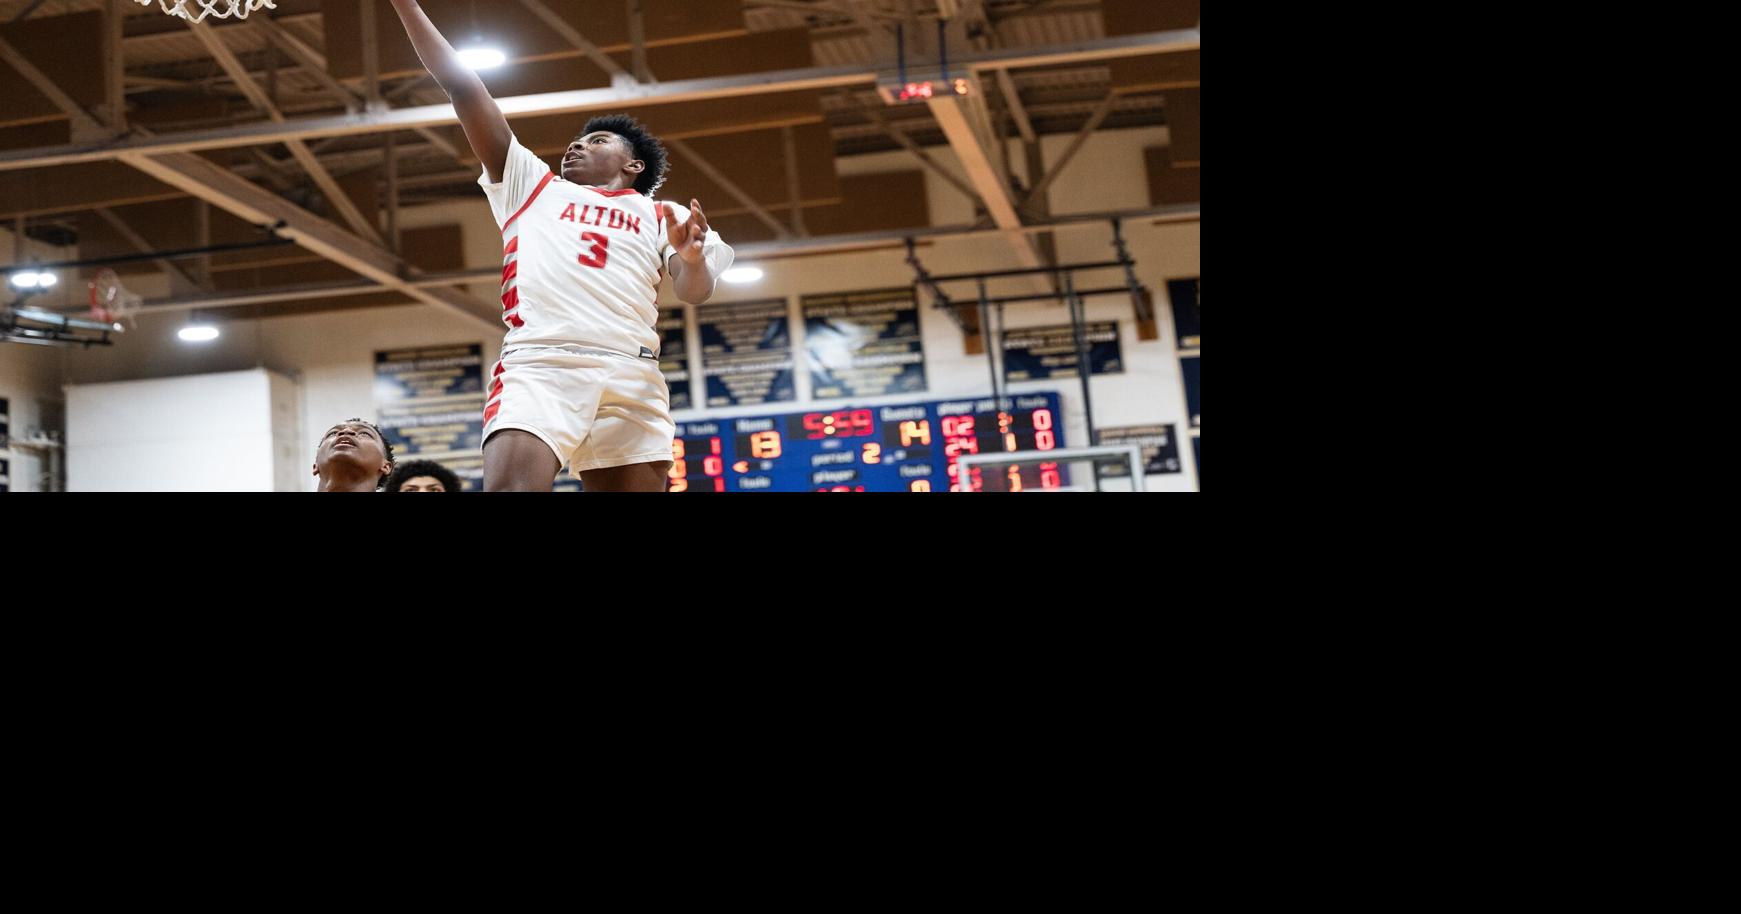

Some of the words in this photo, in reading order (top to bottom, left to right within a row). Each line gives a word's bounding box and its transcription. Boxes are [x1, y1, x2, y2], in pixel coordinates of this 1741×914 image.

[559, 202, 640, 235] ALTON
[577, 231, 609, 269] 3
[802, 408, 874, 440] 5:59
[1032, 408, 1053, 431] 0
[899, 419, 931, 447] 14
[1034, 429, 1055, 451] 0
[703, 455, 724, 477] 0
[862, 442, 881, 465] 2
